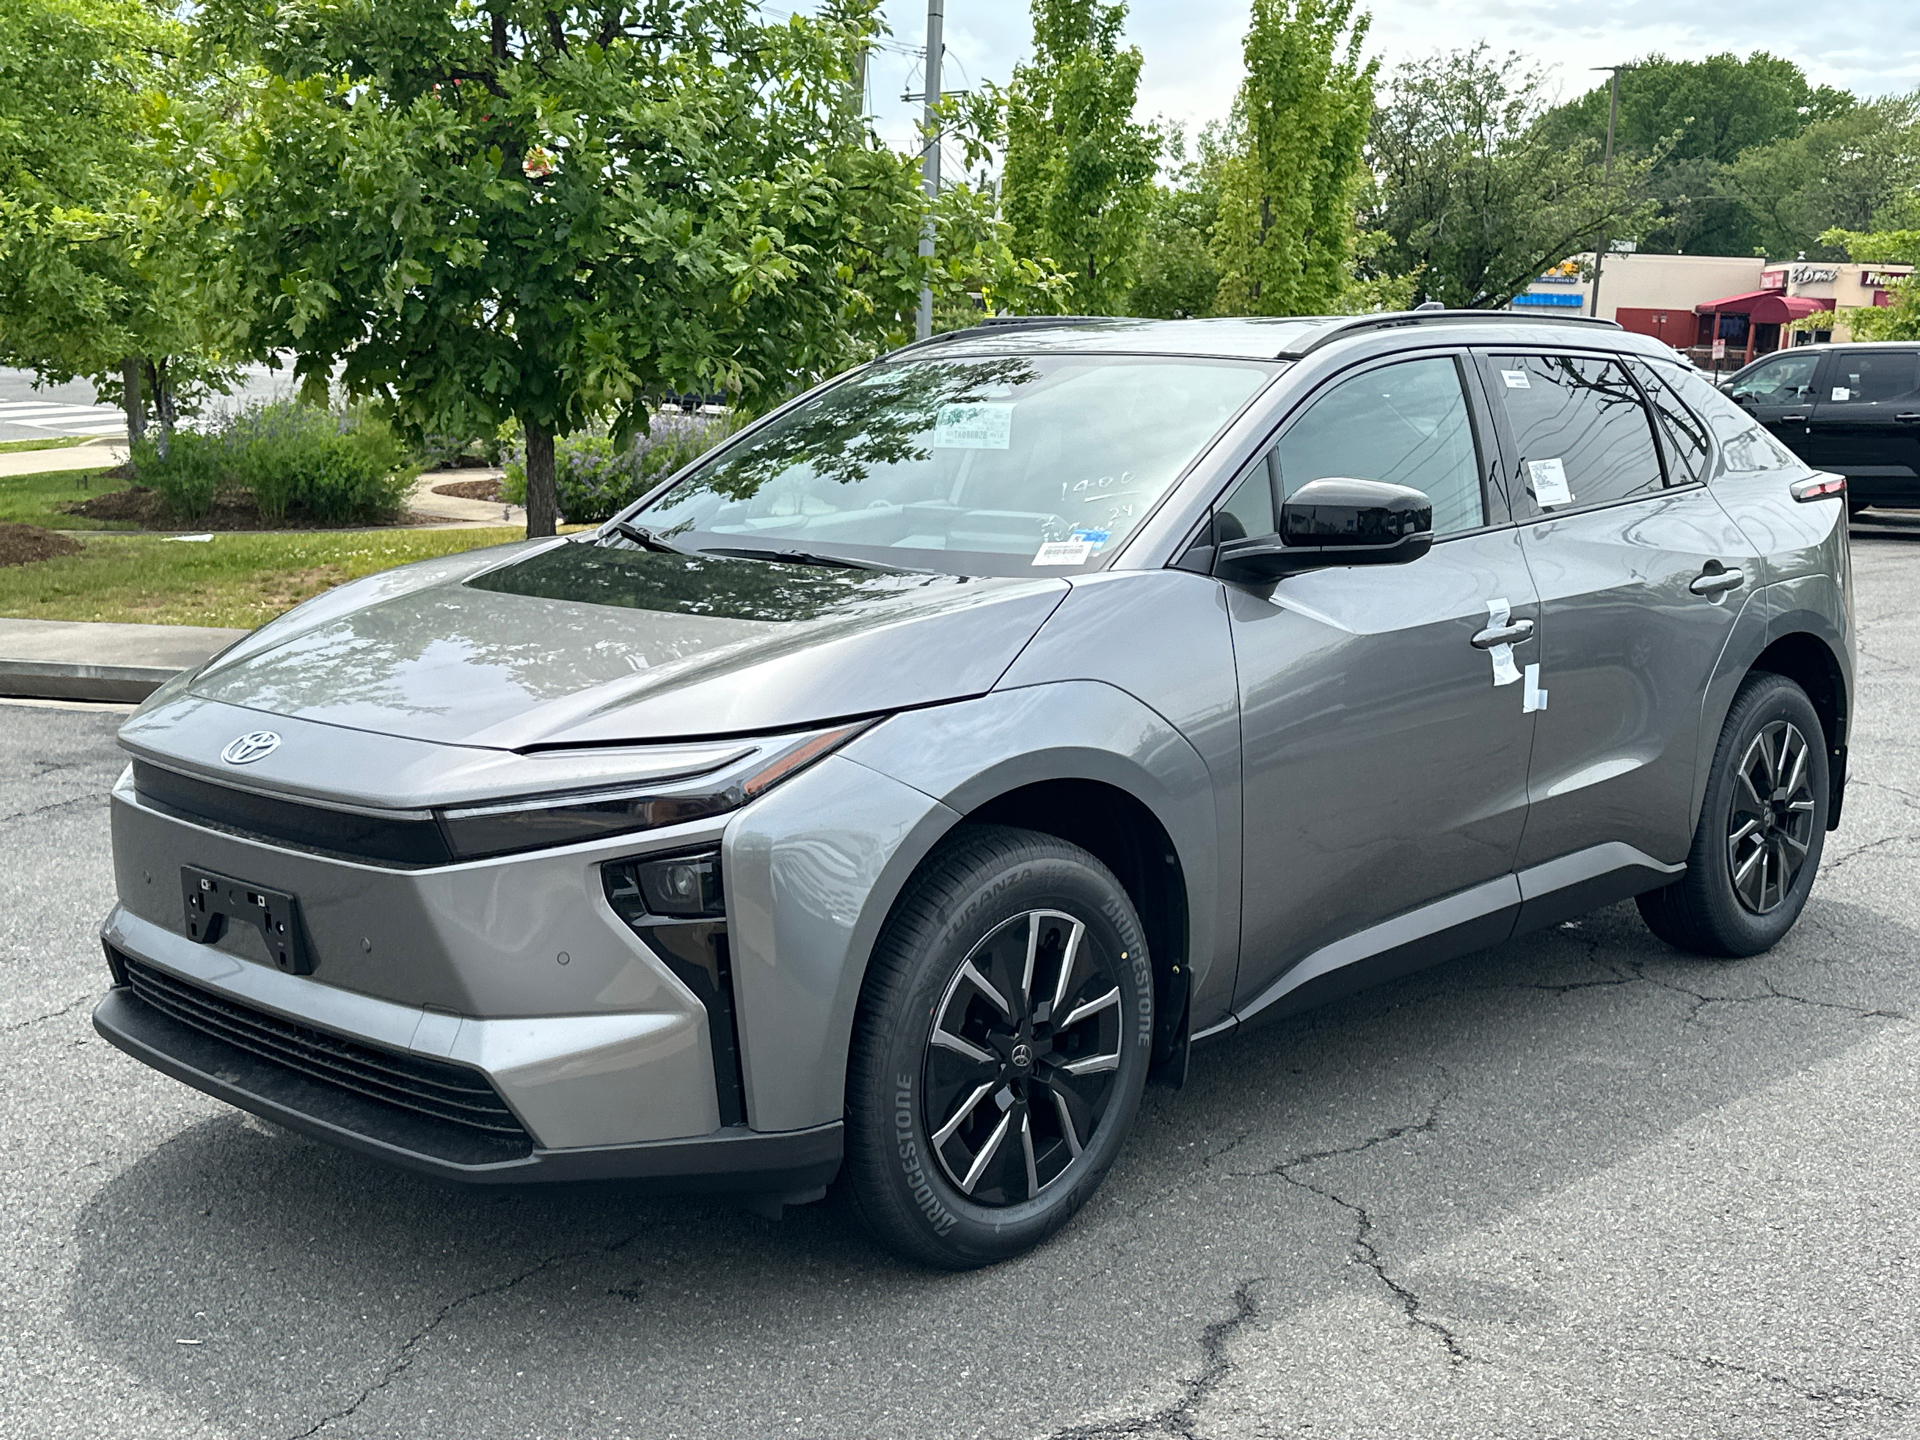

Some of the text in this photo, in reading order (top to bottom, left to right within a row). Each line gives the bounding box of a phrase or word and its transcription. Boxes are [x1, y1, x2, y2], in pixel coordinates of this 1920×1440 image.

[941, 867, 1034, 948] TURANZA
[1101, 896, 1152, 1047] BRIDGESTONE
[895, 1073, 959, 1238] BRIDGESTONE
